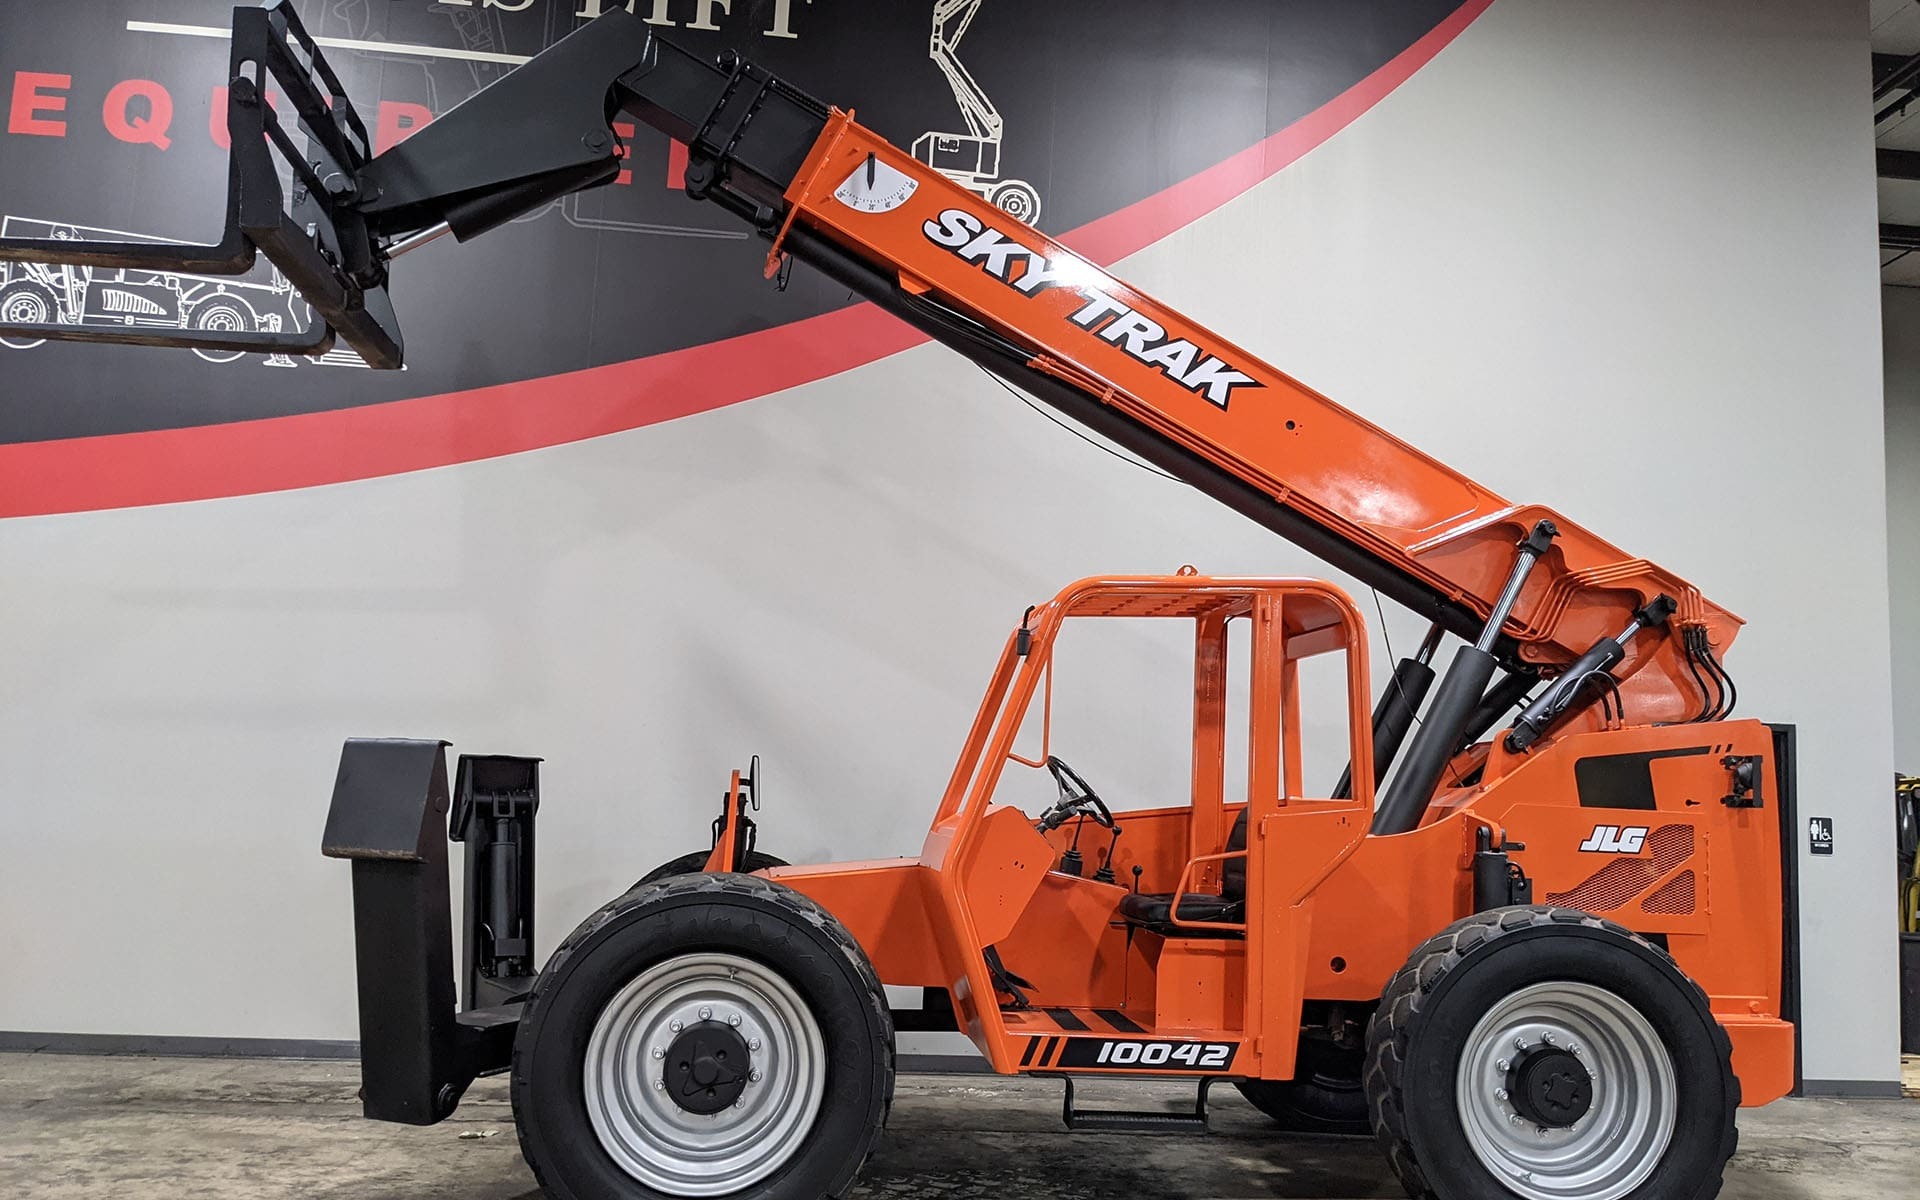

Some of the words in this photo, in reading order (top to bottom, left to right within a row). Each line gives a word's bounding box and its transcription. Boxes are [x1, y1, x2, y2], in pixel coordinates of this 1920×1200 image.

[922, 208, 1060, 298] SKY
[1066, 285, 1267, 412] TRAK
[1578, 824, 1650, 854] JLG
[1096, 1041, 1230, 1067] 10042
